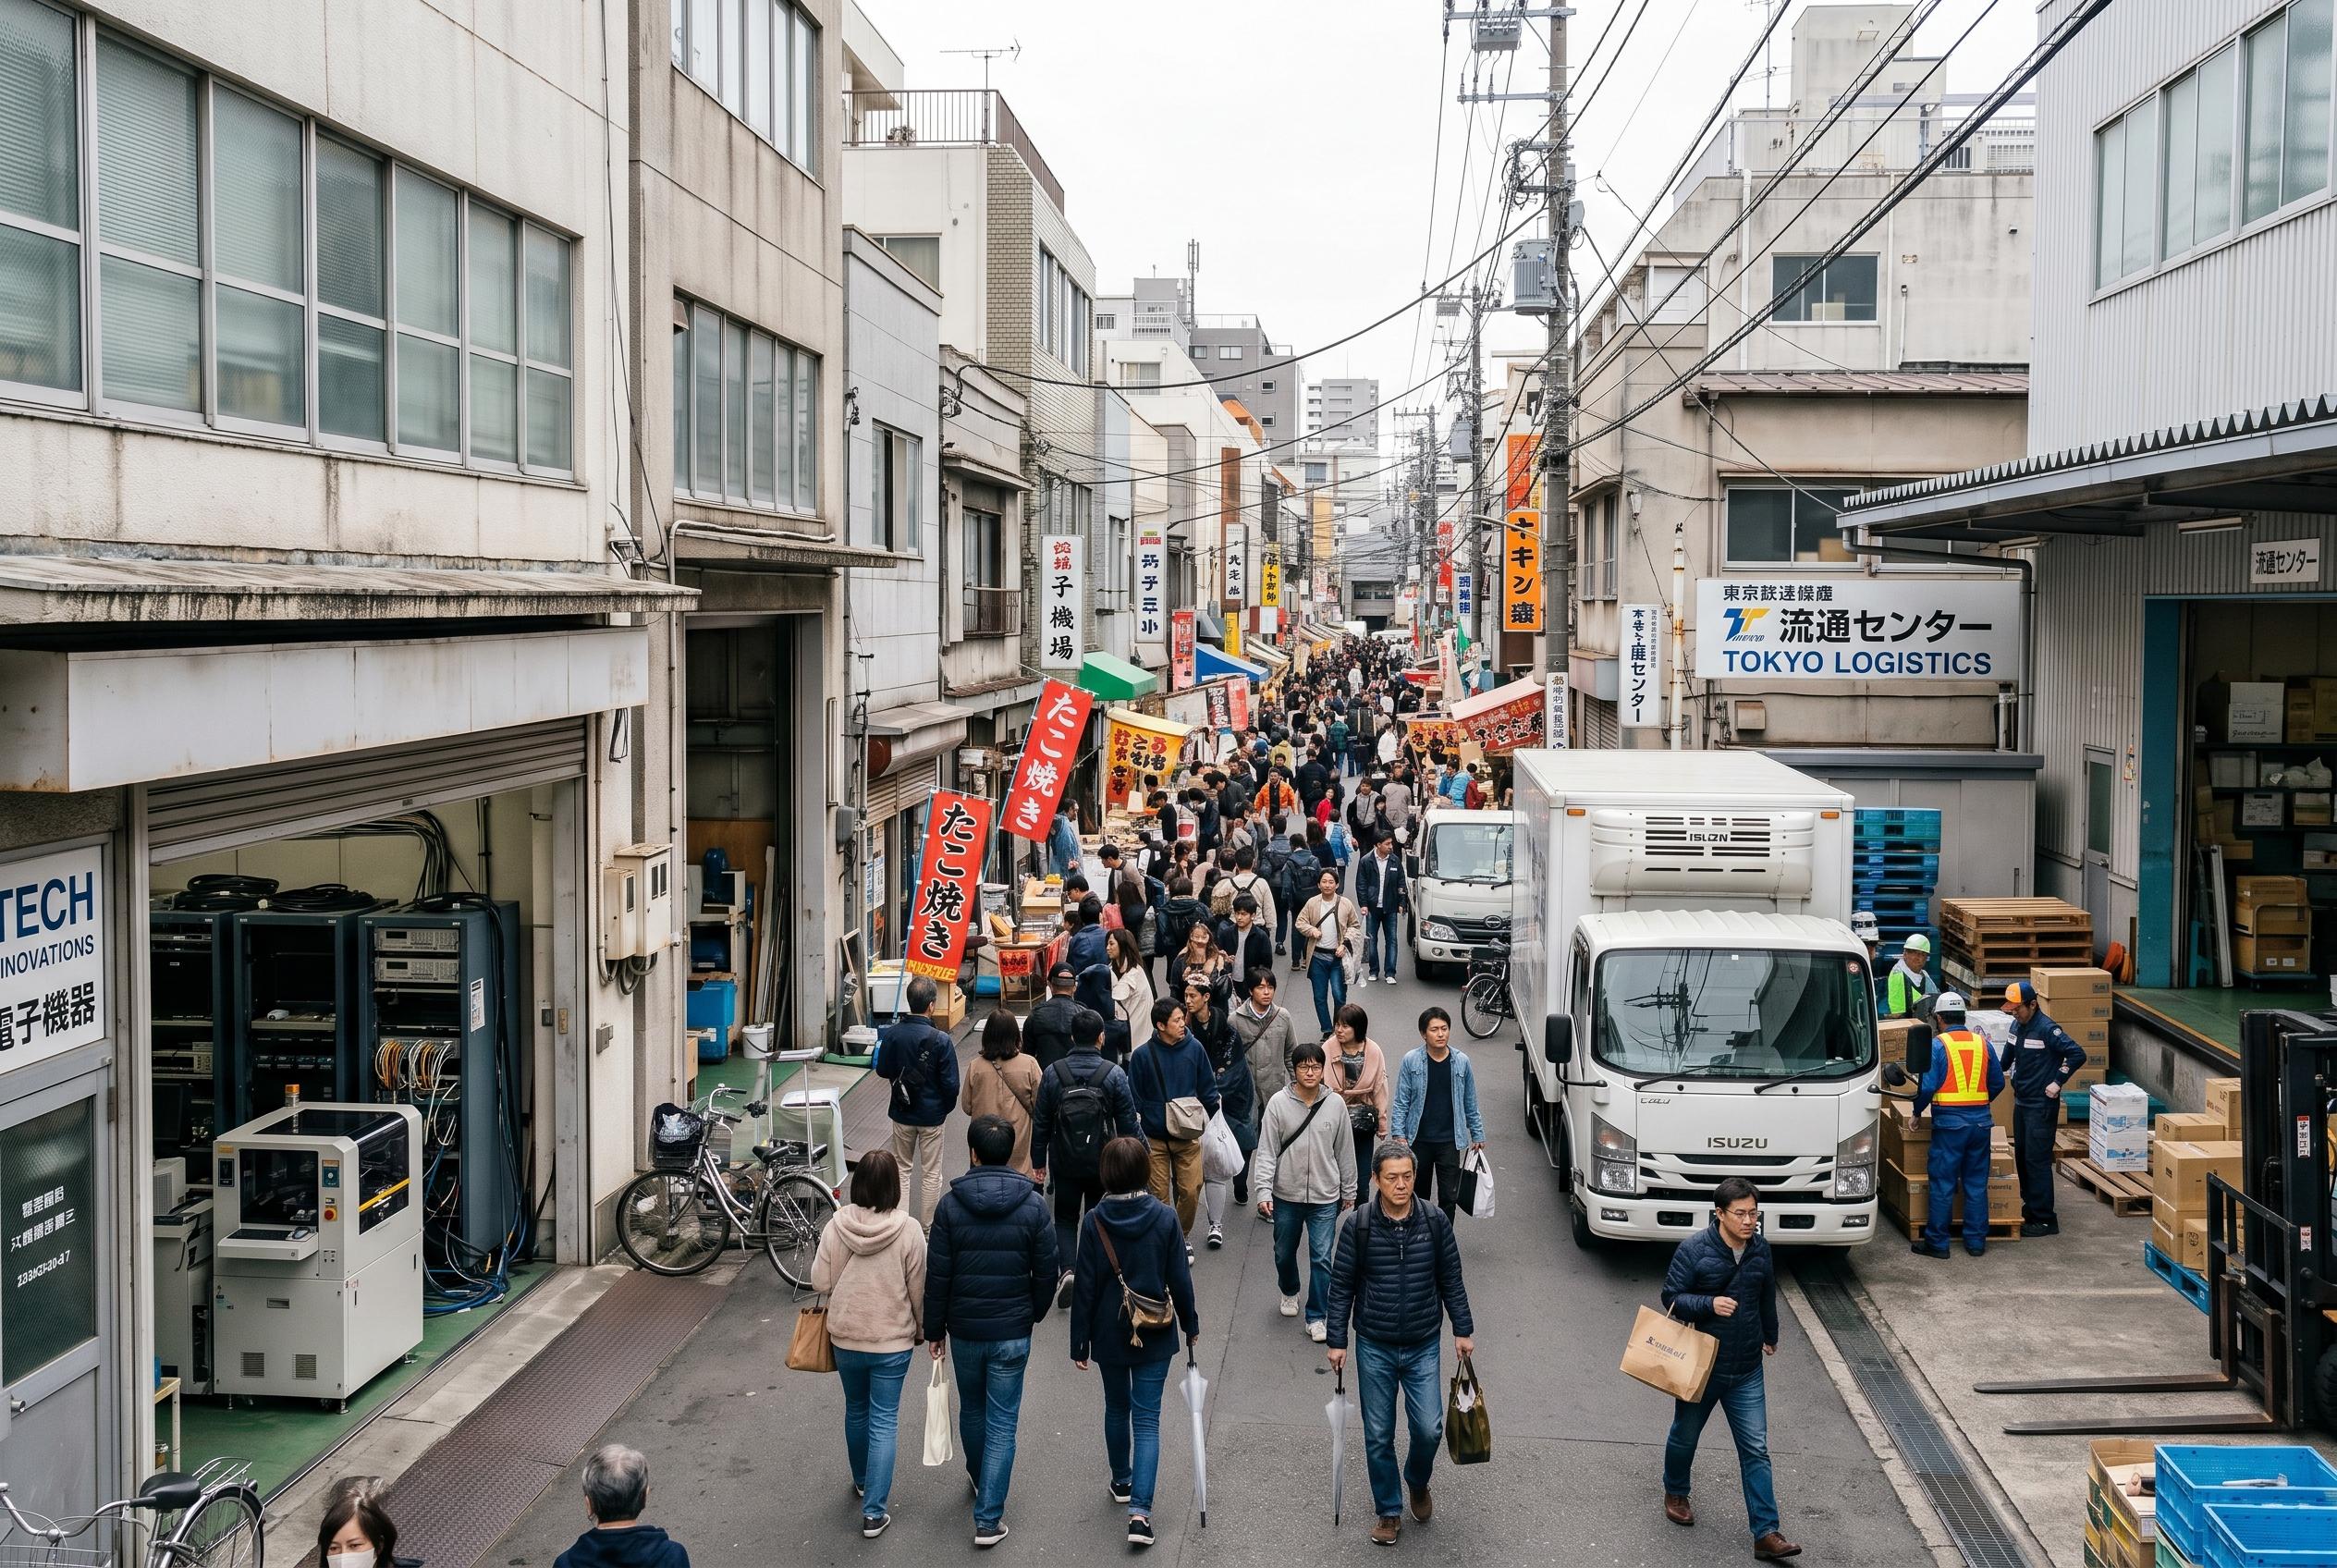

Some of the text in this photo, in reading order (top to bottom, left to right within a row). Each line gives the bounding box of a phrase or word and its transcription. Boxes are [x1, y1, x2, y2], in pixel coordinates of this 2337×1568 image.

[1779, 607, 1992, 643] 流通センター
[1722, 650, 1992, 675] TOKYO LOGISTICS
[1015, 692, 1078, 831] たこ焼き
[0, 871, 93, 943] TECH
[920, 802, 976, 960] たこ焼き
[1707, 1137, 1768, 1149] ISUZU
